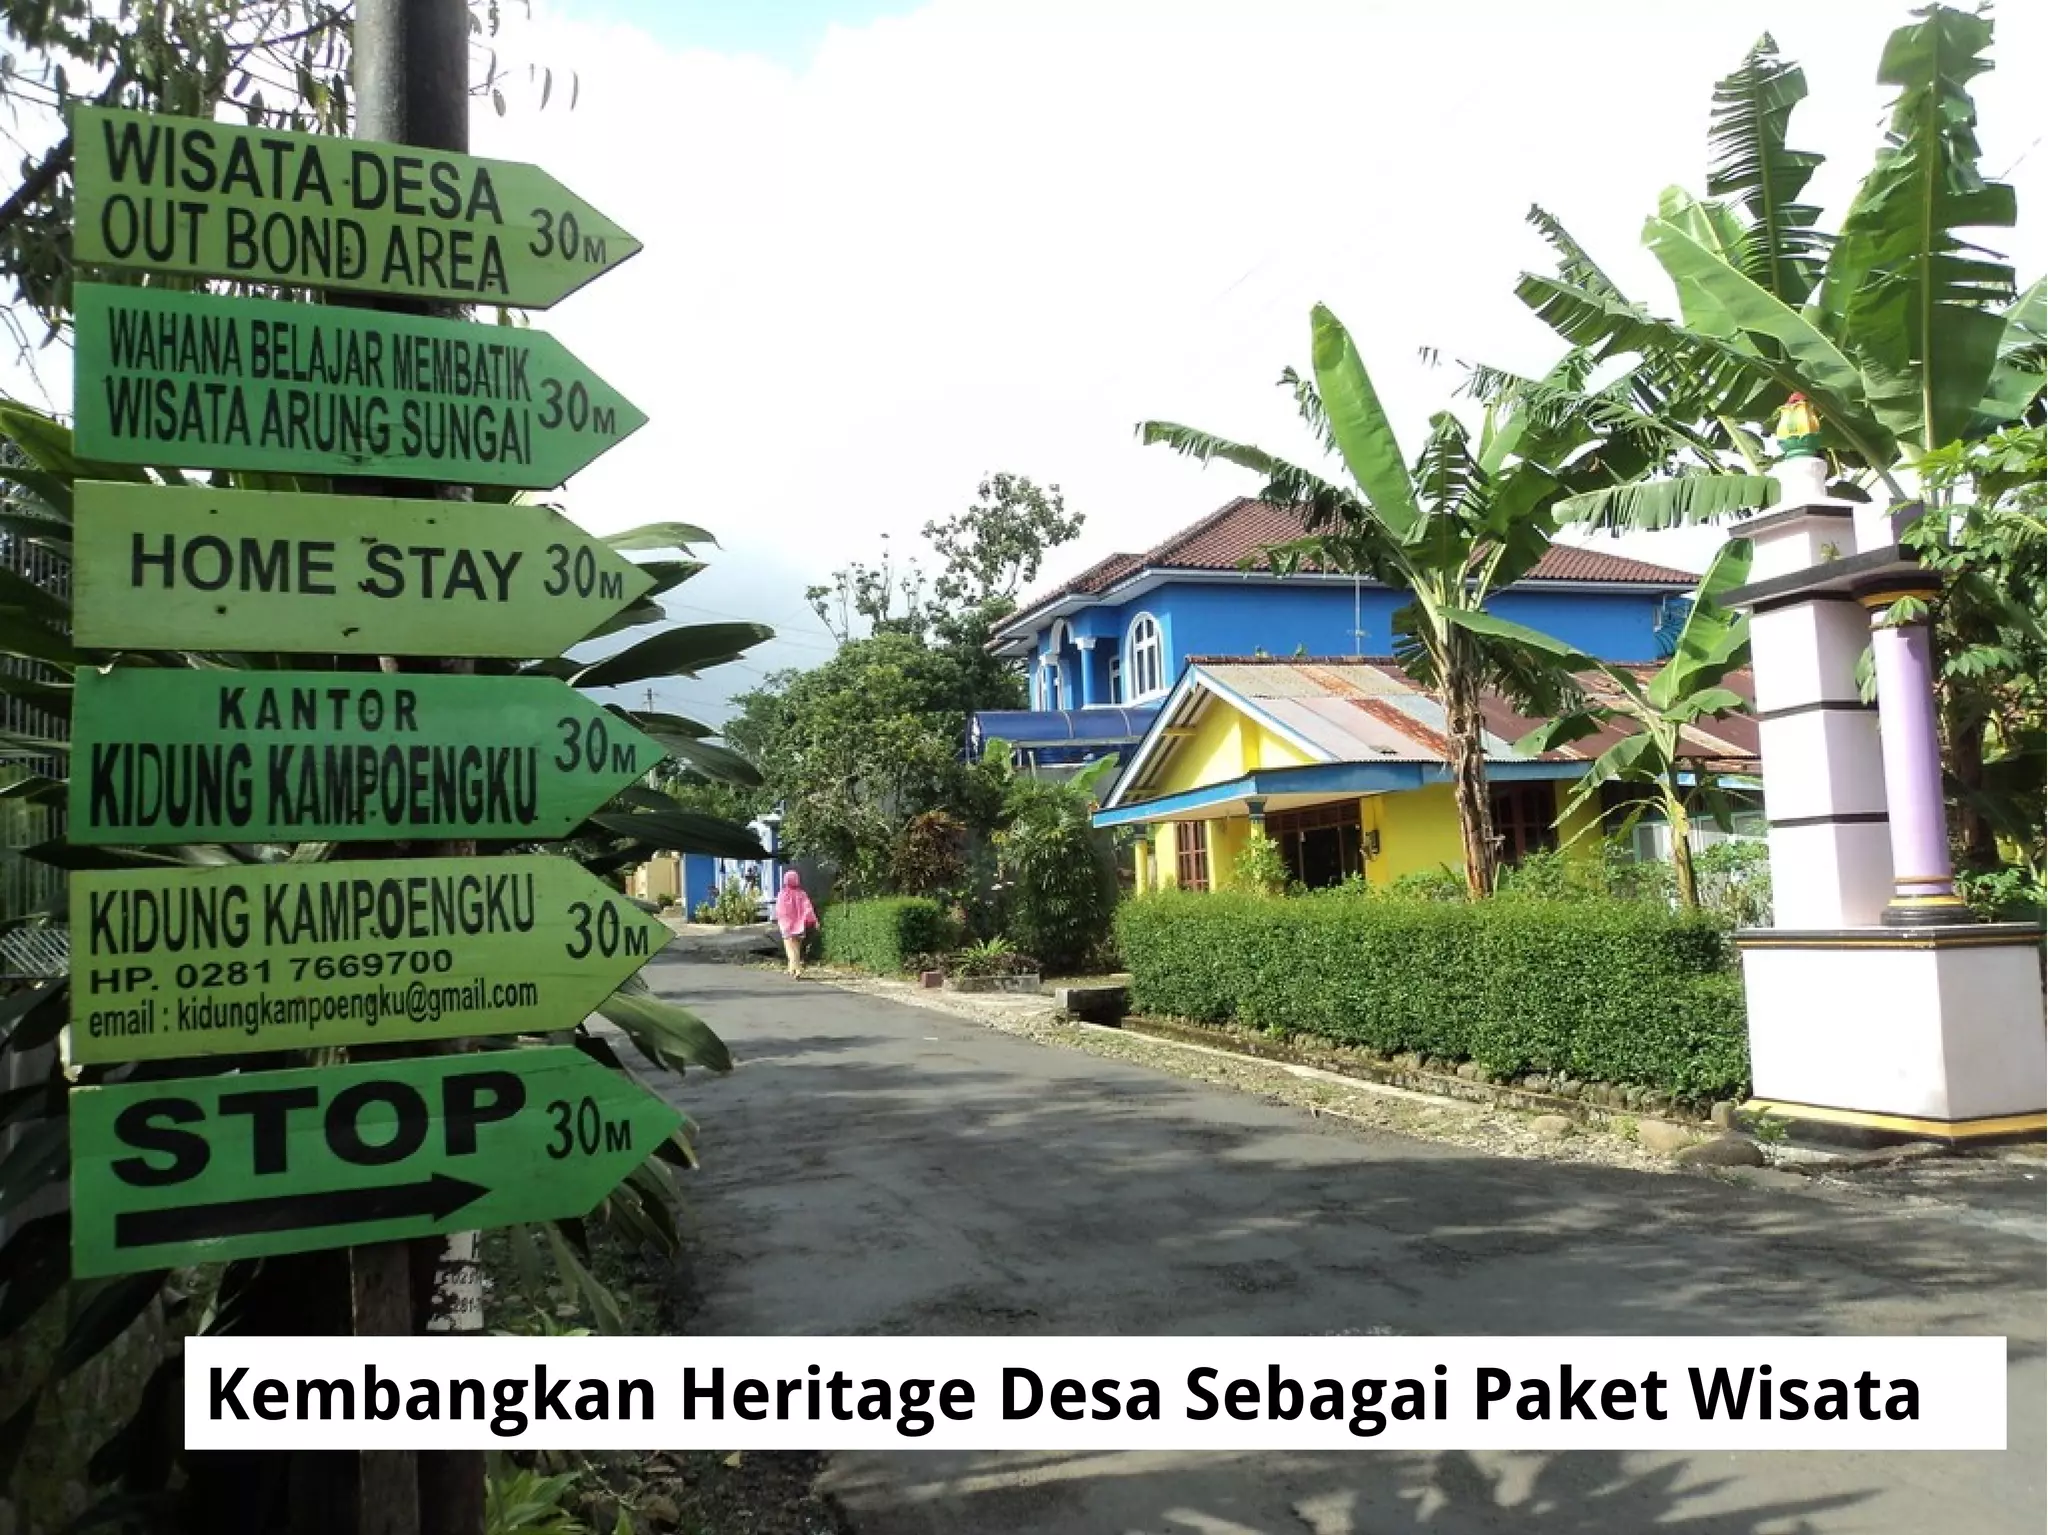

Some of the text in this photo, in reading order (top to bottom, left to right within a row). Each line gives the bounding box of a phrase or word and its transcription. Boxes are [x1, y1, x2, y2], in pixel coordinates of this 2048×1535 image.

[103, 119, 503, 224] WISATA DESA
[102, 194, 509, 295] OUT BOND AREA
[109, 307, 532, 402] WAHANA BELAJAR MEMBATIK
[106, 375, 531, 466] WISATA ARUNG SUNGAI
[131, 532, 523, 601] HOME STAY
[218, 687, 417, 733] KANTOR
[90, 742, 538, 828] KIDUNG KAMPOENGKU
[89, 873, 535, 956] KIDUNG KAMPOENGKU
[89, 999, 154, 1038] email
[177, 976, 538, 1034] kidungkampoengku@gmail.com
[90, 948, 453, 994] HP. 0281 7669700
[111, 1070, 526, 1188] STOP
